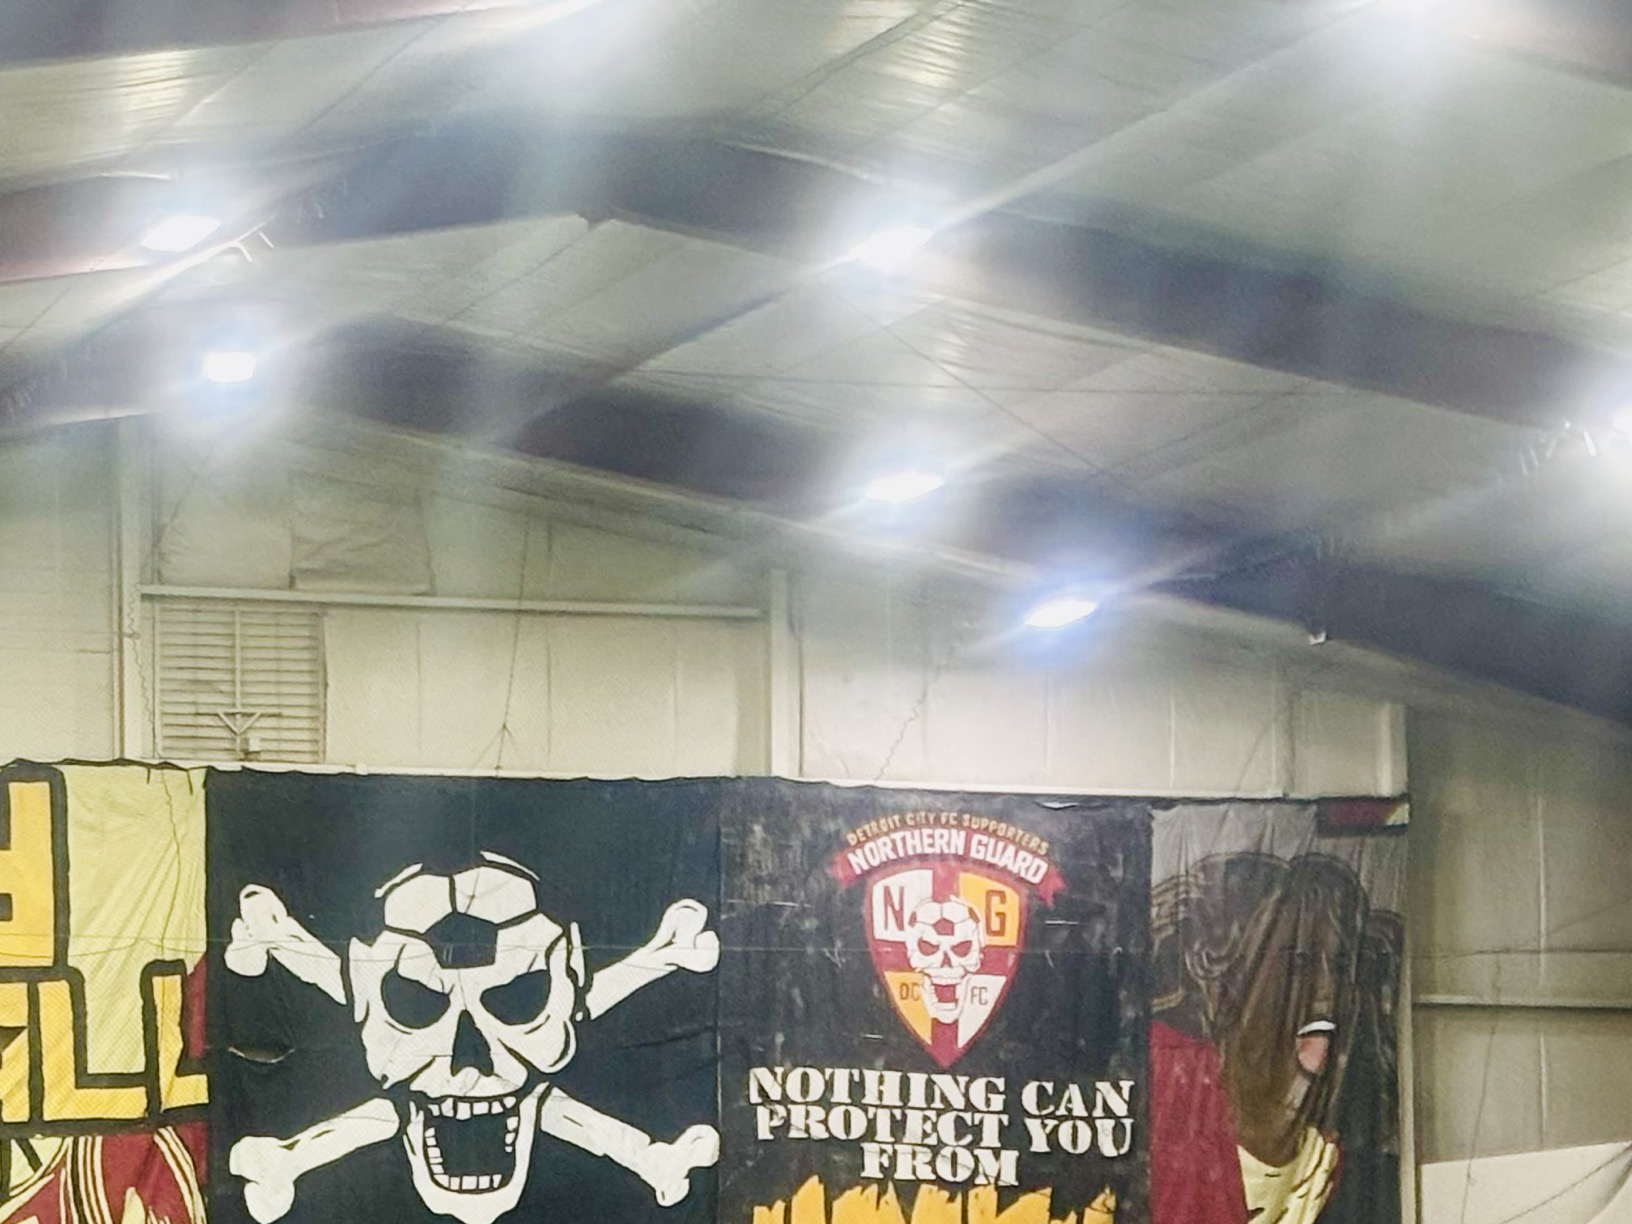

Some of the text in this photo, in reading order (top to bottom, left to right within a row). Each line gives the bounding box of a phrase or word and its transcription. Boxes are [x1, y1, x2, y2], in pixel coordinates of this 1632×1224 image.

[846, 810, 1050, 856] DETROIT CITY FC SUPPORTERS
[847, 828, 1049, 885] NORTHERN GUARD
[970, 986, 988, 1006] FC
[749, 1066, 1136, 1118] NOTHING CAN
[756, 1104, 1136, 1158] PROTECT YOU
[860, 1142, 1021, 1187] FROM
